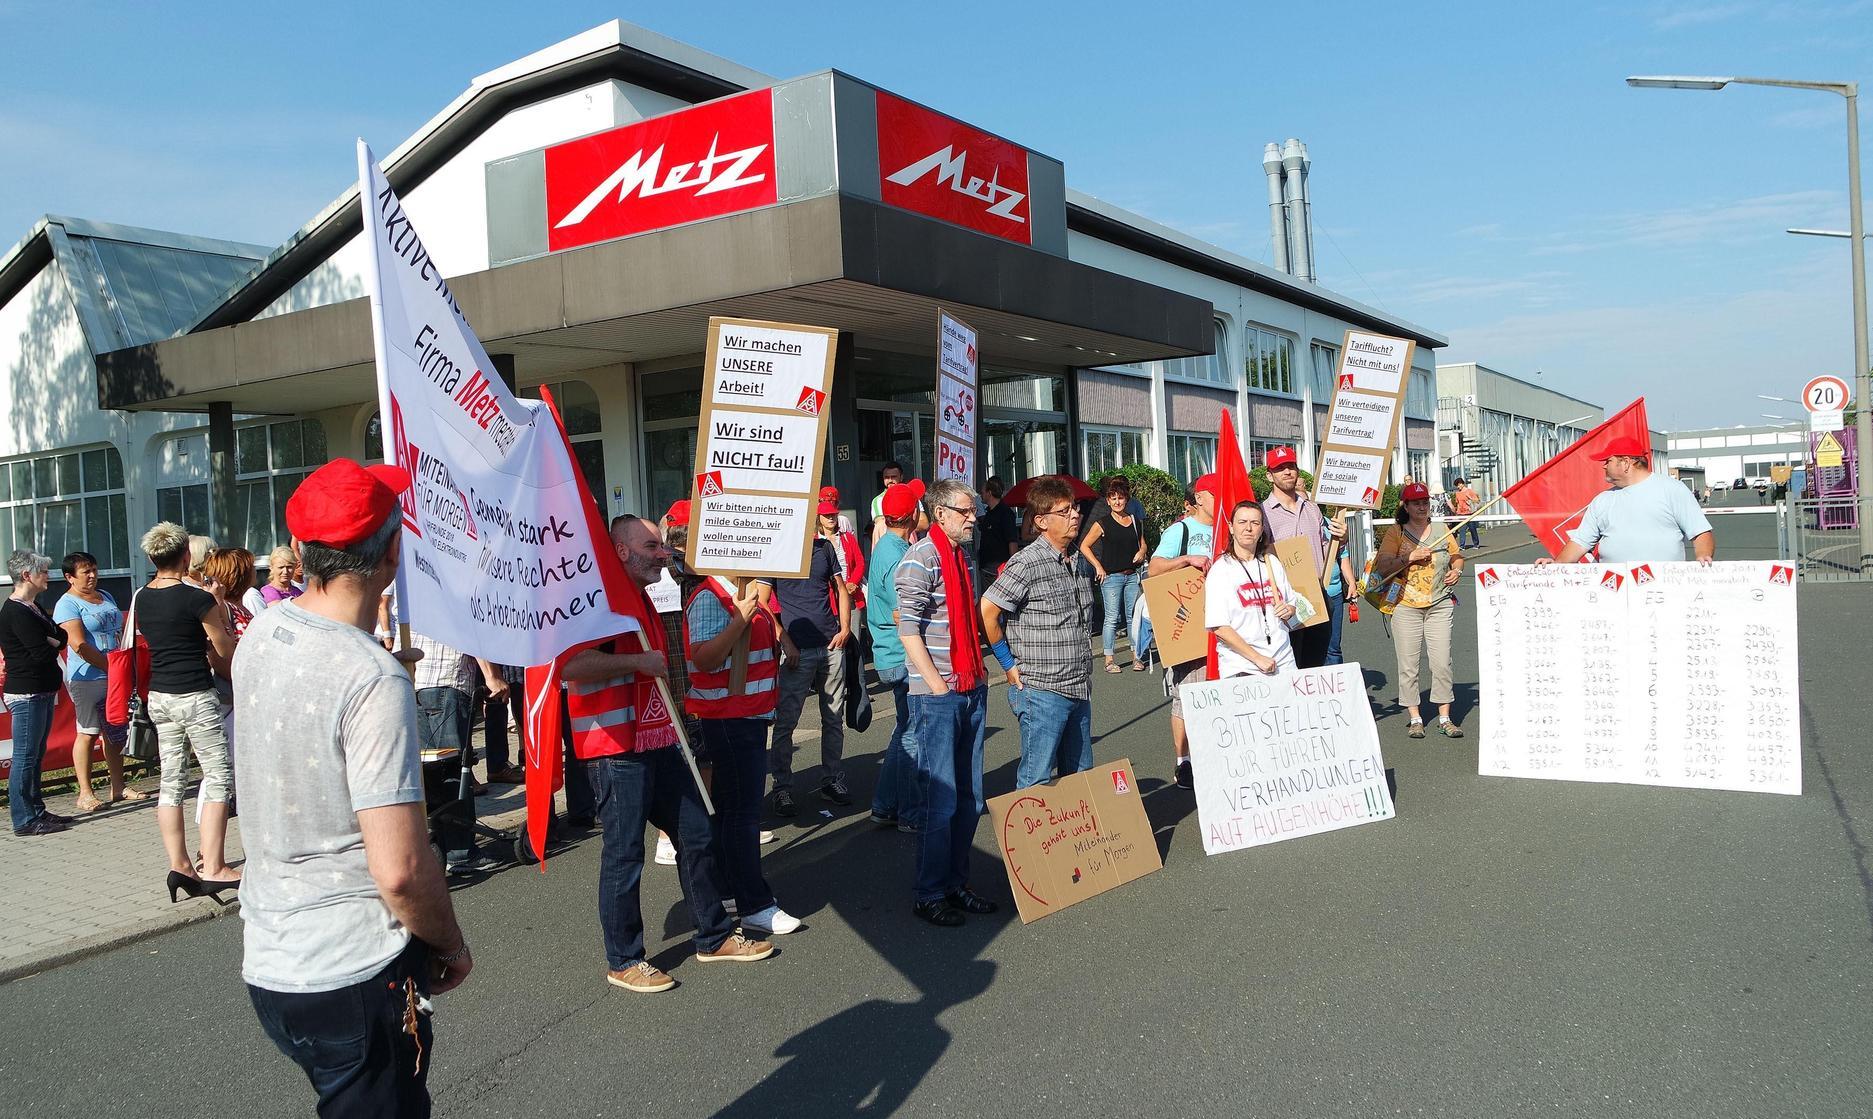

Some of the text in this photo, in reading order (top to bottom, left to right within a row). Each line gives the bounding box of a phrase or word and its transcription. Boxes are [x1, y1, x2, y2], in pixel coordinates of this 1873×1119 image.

[553, 131, 769, 229] Metz
[885, 144, 1026, 223] Metz
[724, 335, 802, 353] Wir machen
[1350, 340, 1394, 354] Tarifflucht?
[721, 357, 774, 373] UNSERE
[1346, 356, 1400, 371] Nicht mit uns!
[414, 324, 461, 396] Firma
[454, 369, 500, 431] Metz
[718, 379, 765, 394] Arbeit!
[1338, 398, 1390, 413] Wir verteidigen
[1814, 387, 1834, 405] 20
[1335, 413, 1363, 422] unseren
[715, 421, 784, 441] Wir sind
[1332, 425, 1375, 439] Tarifvertrag!
[712, 450, 805, 470] NICHT faul!
[837, 446, 849, 460] 55
[940, 442, 966, 473] Pro
[1326, 457, 1371, 469] Wir brauchen
[1322, 471, 1358, 481] die soziale
[1320, 485, 1346, 494] Einheit!
[432, 494, 467, 534] MORGEN
[706, 501, 794, 515] Wir bitten nicht um
[518, 515, 575, 546] stark
[704, 517, 782, 529] milde Gaben, wir
[703, 532, 772, 543] wollen unseren
[701, 546, 762, 558] Anteil haben!
[517, 552, 593, 588] Rechte
[1535, 593, 1544, 603] A
[486, 588, 603, 631] Arbeitnehmer
[1232, 681, 1271, 704] SIND
[1292, 672, 1346, 697] KEINE
[1648, 684, 1658, 697] 6
[1211, 698, 1350, 749] BITTSTELLER
[1224, 735, 1337, 779] WIR FÜHREN
[1223, 755, 1384, 812] VERHANDLUNGEN
[1023, 799, 1091, 836] Die Zukunft
[1041, 815, 1100, 855] gehört uns!
[1210, 817, 1243, 847] AUF
[1074, 830, 1122, 857] Miteinander
[1088, 842, 1135, 876] für Morgen
